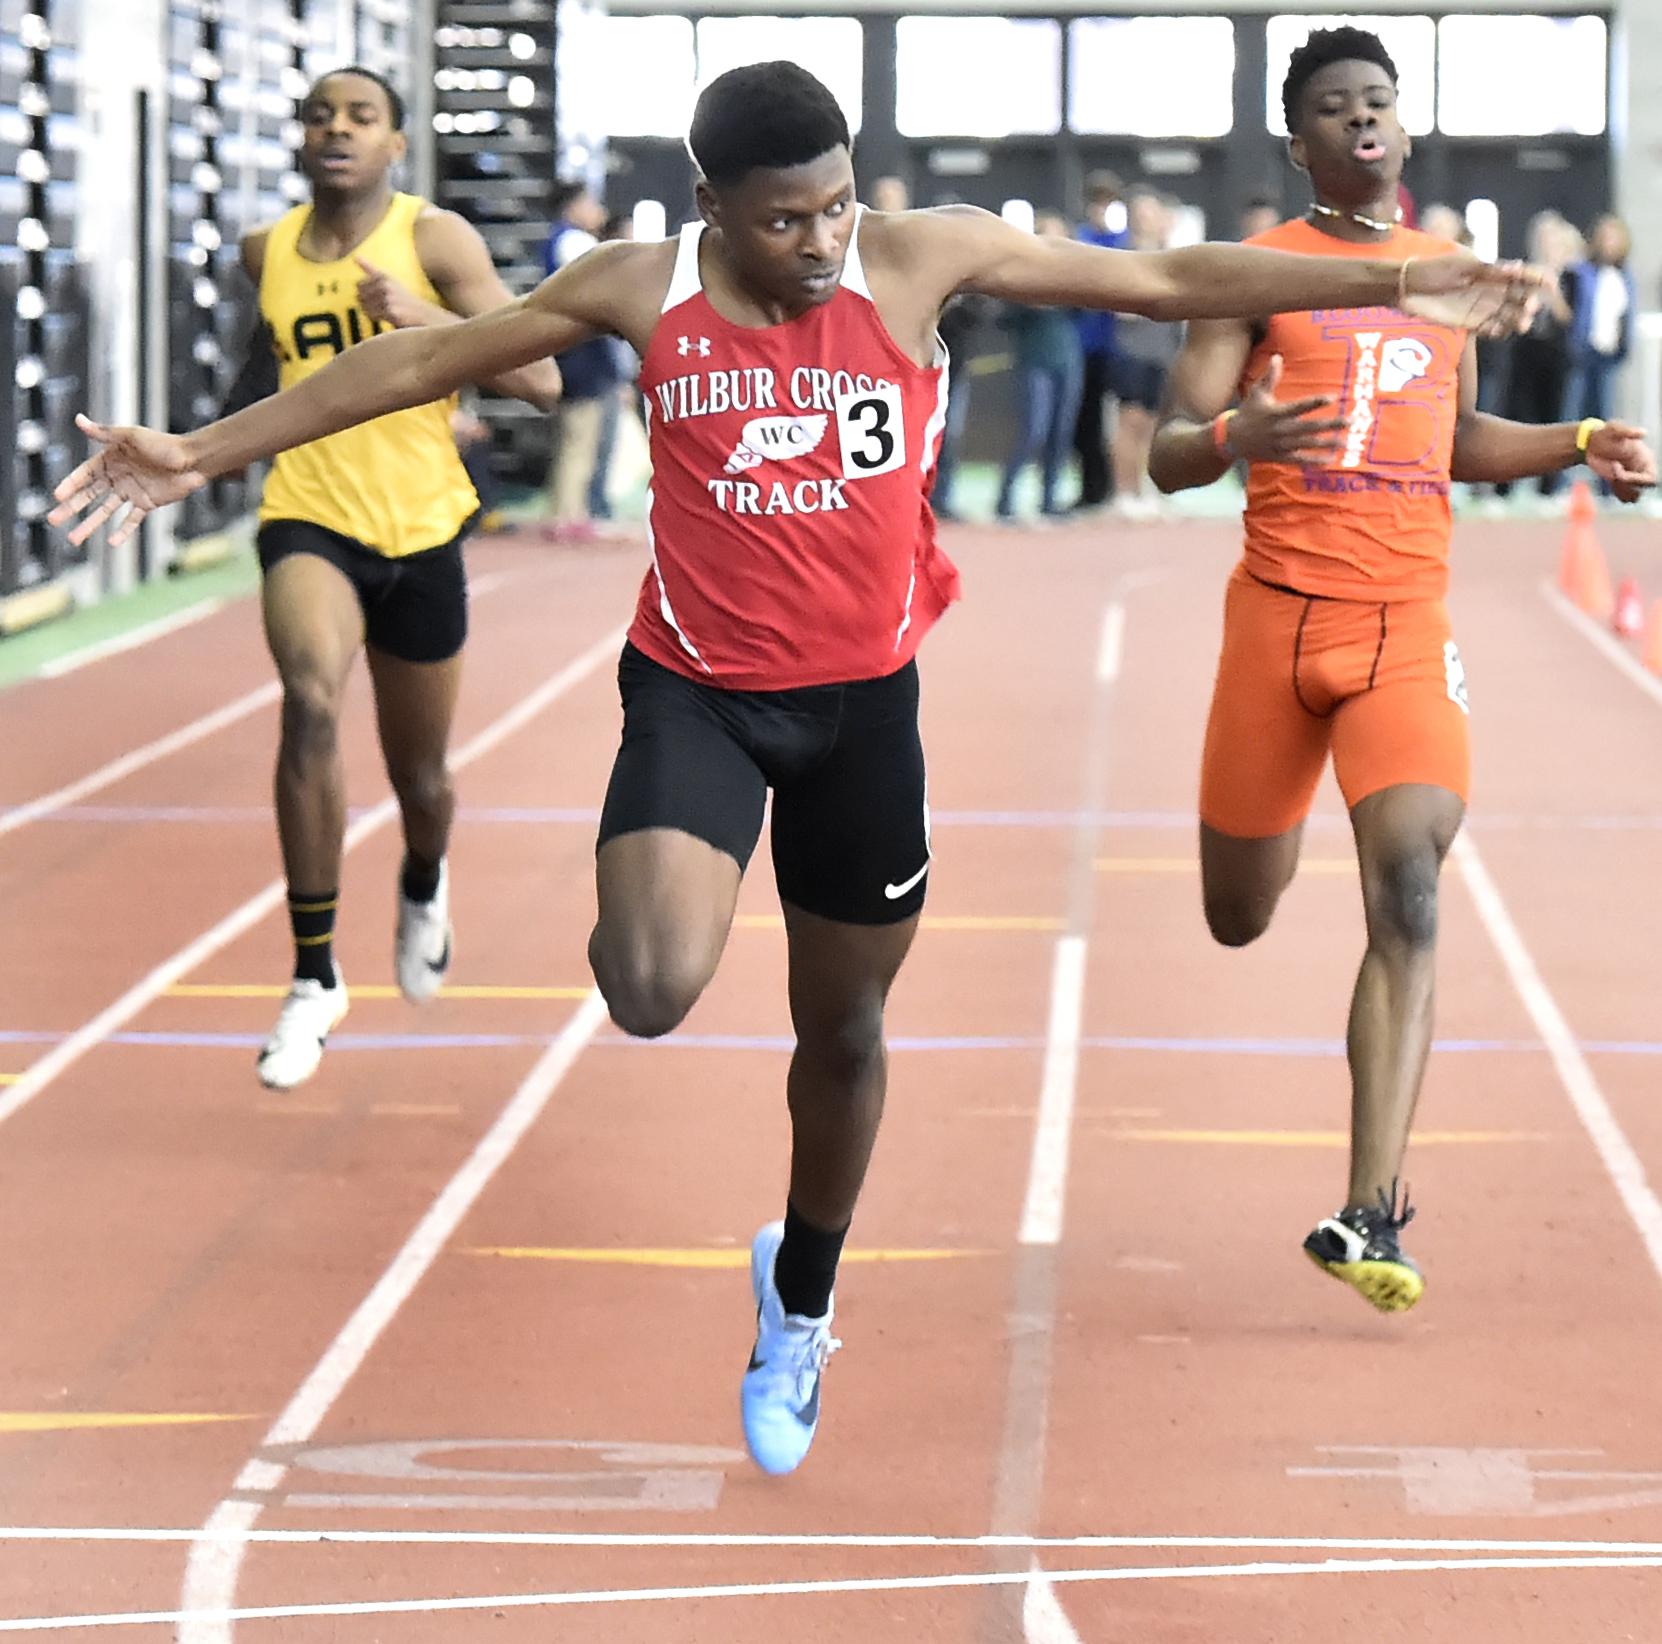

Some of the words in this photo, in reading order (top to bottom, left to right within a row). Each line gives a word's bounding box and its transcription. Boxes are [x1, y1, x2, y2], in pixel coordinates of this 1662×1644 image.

[655, 367, 777, 423] WILBUR
[790, 367, 893, 411] CRO
[759, 424, 805, 445] WC
[847, 398, 894, 469] 3
[708, 478, 849, 515] TRACK
